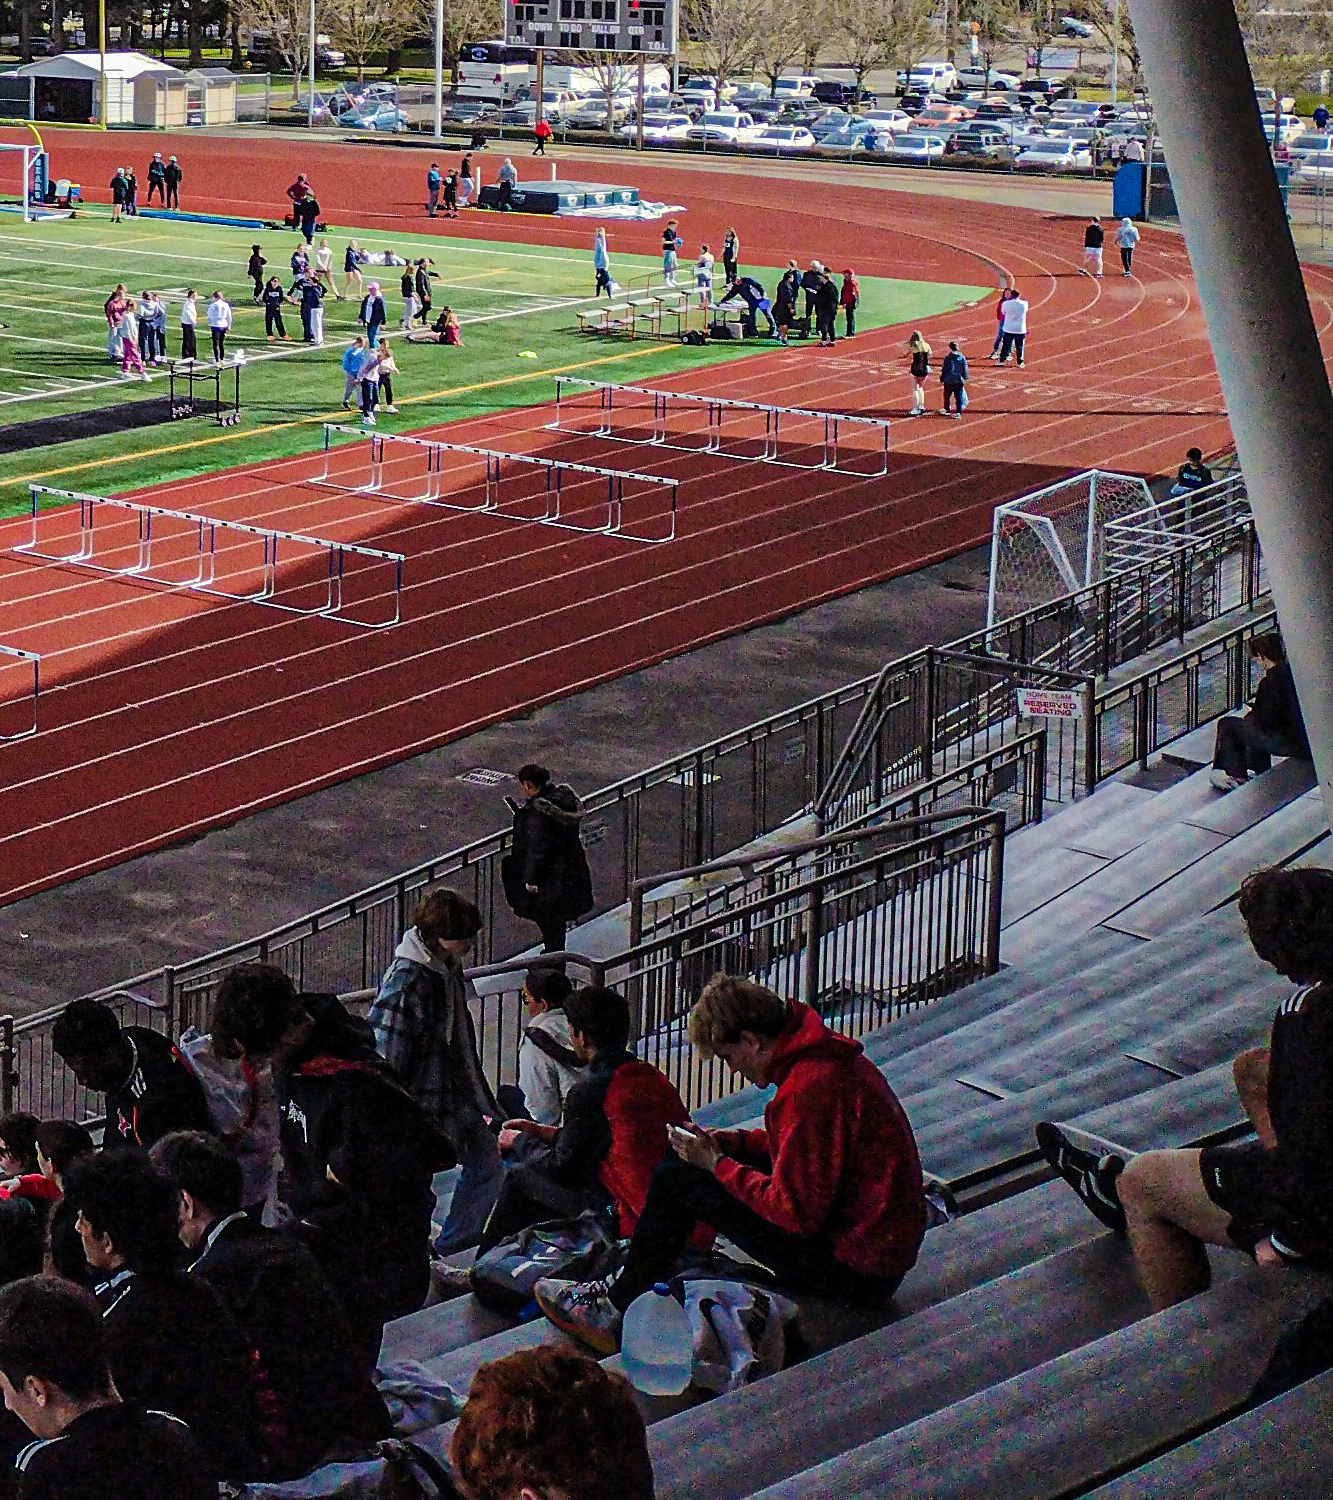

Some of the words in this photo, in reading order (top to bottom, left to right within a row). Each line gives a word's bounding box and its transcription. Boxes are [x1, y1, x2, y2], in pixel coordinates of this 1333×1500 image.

[528, 22, 553, 32] DOWN
[559, 23, 570, 32] TO
[591, 25, 608, 33] BALL
[609, 25, 621, 34] ON
[628, 25, 645, 36] QTR
[1023, 699, 1077, 710] RESERVED
[1029, 707, 1073, 717] SEATING
